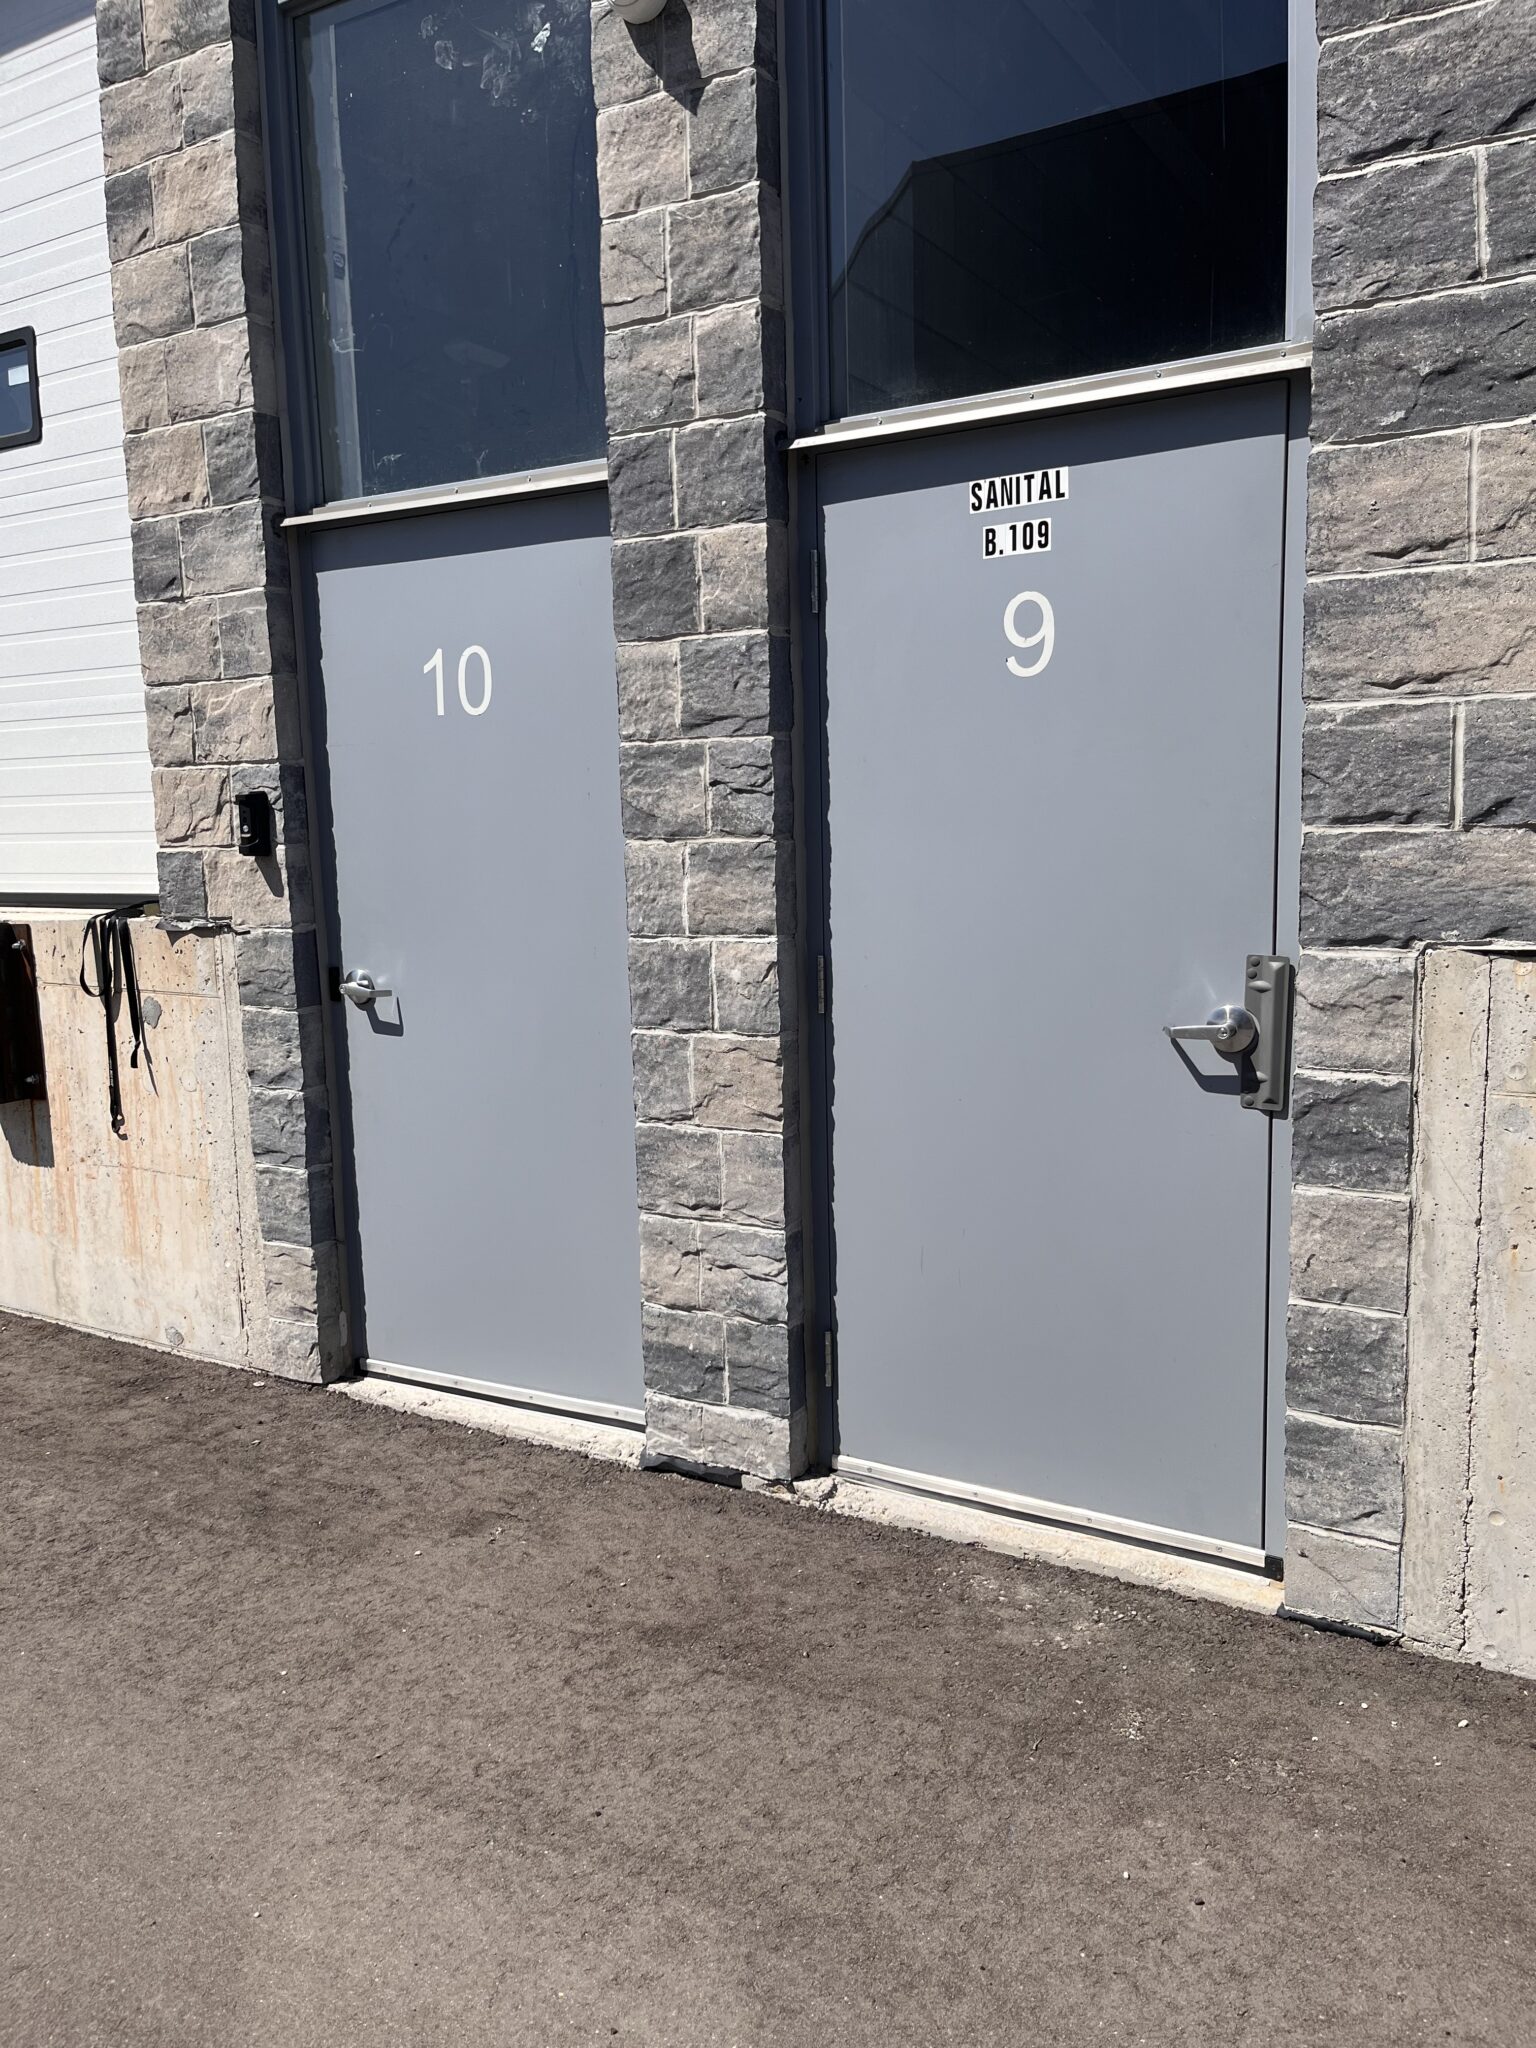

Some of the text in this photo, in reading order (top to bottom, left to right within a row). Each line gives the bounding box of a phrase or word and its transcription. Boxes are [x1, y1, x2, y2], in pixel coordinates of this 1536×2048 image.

[970, 469, 1066, 512] SANITAL
[984, 520, 1050, 557] B.109
[1003, 590, 1055, 678] 9
[423, 644, 492, 716] 10
